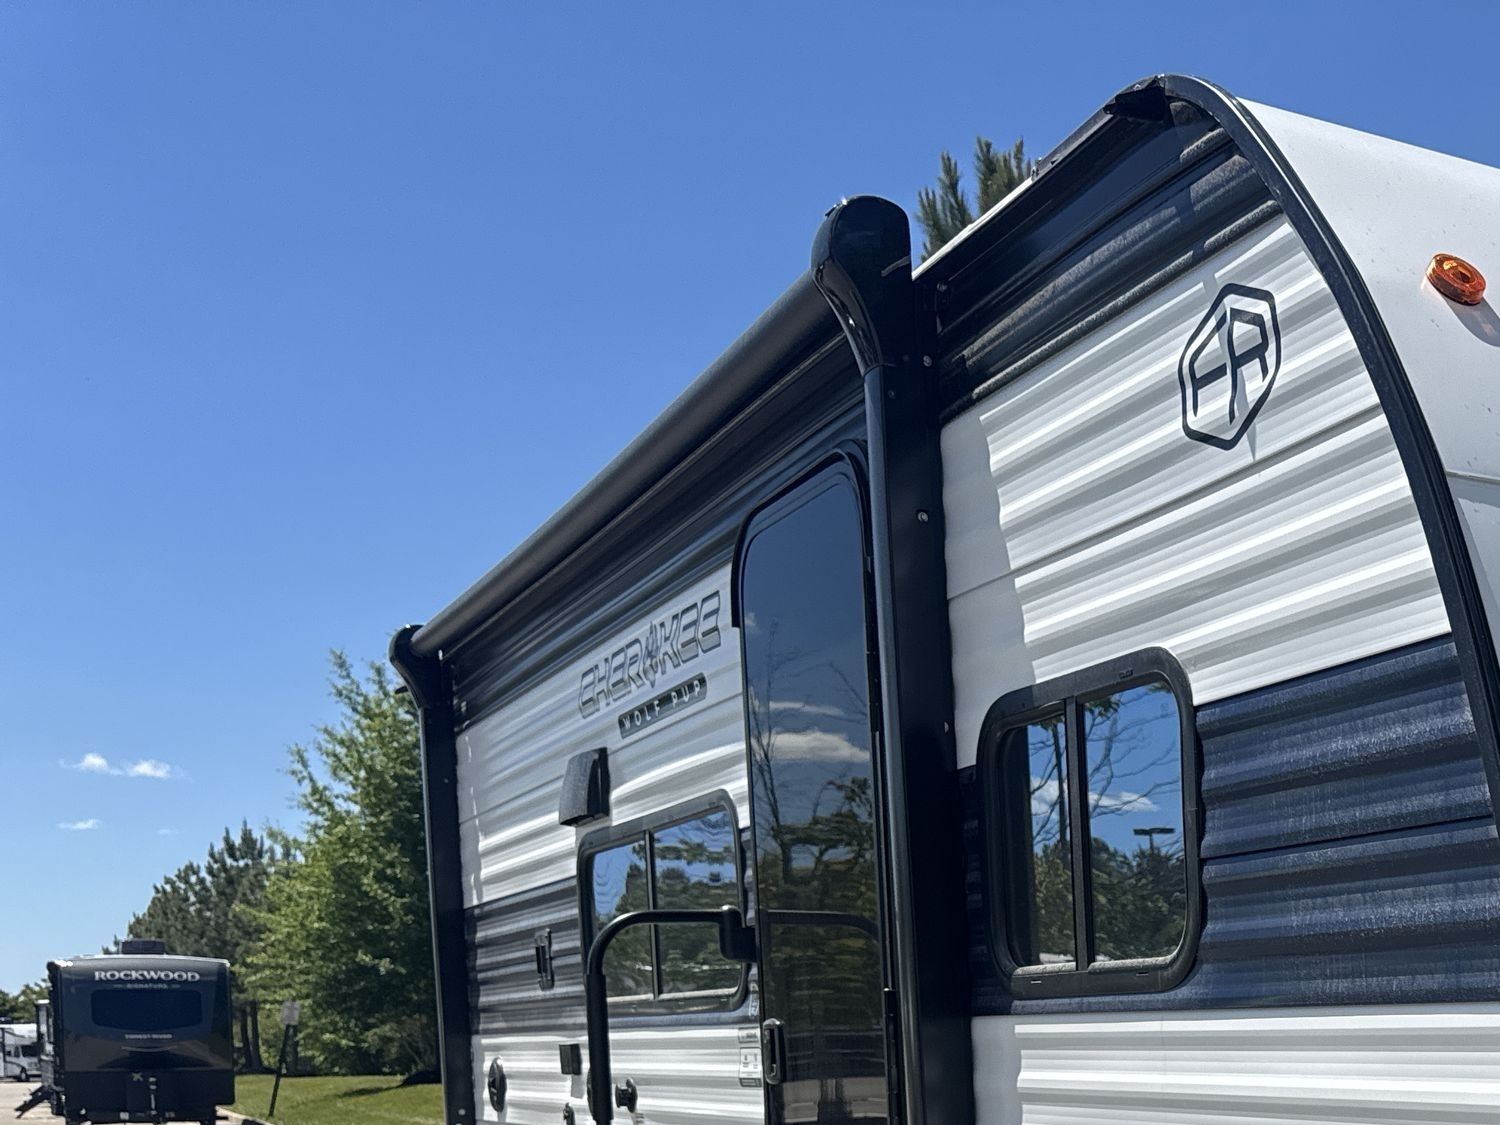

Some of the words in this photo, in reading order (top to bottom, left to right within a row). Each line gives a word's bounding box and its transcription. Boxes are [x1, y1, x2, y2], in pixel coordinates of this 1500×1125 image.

[622, 701, 661, 729] WOLF
[671, 680, 701, 706] PUP
[94, 970, 200, 982] ROCKWOOD
